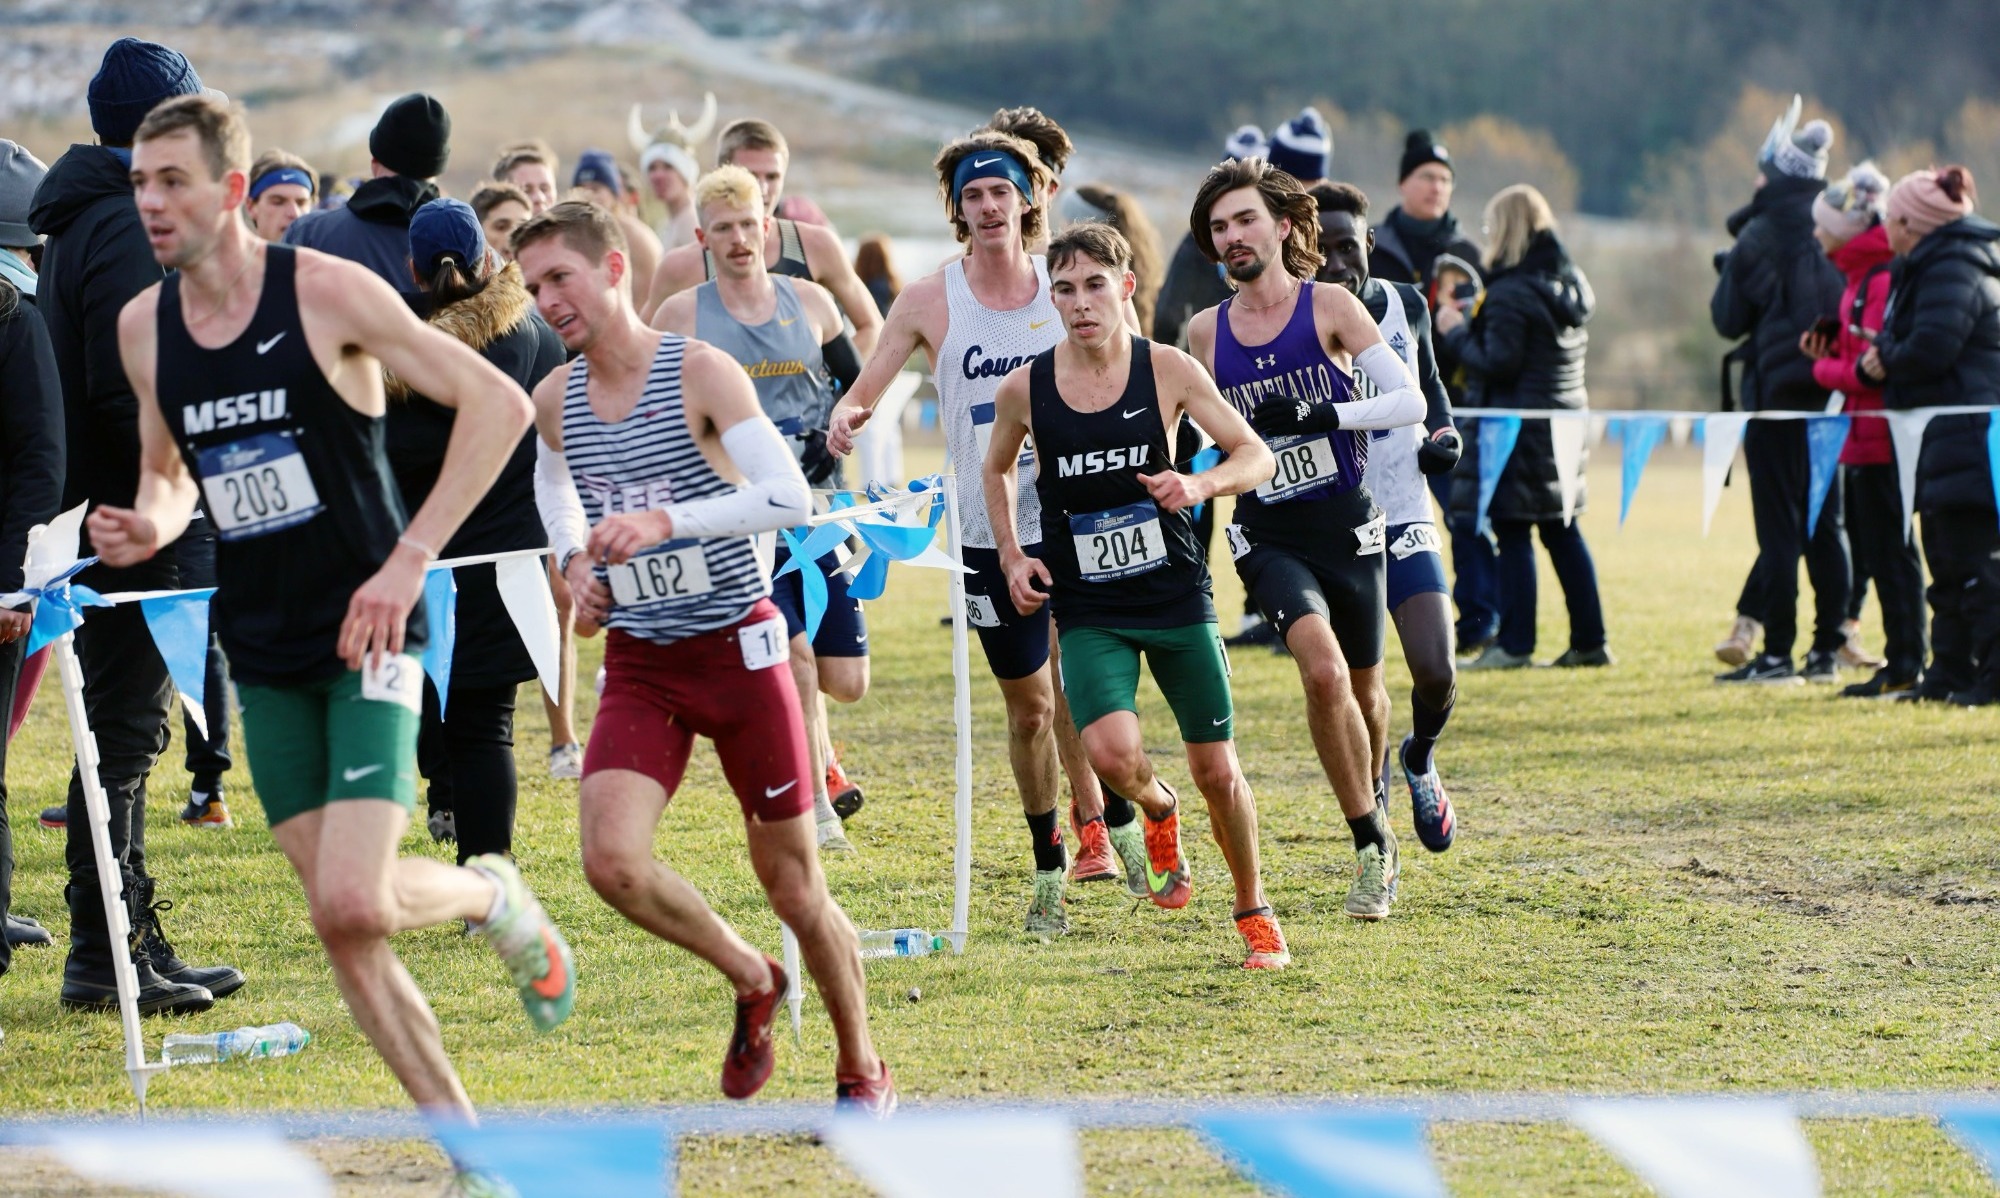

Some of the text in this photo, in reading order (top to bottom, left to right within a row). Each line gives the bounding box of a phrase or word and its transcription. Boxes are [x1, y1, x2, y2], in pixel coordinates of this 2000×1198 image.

[183, 388, 287, 435] MSSU
[1057, 444, 1149, 478] MSSU
[1271, 445, 1318, 490] 208
[224, 467, 288, 522] 203
[1093, 527, 1148, 570] 204
[627, 554, 689, 601] 162
